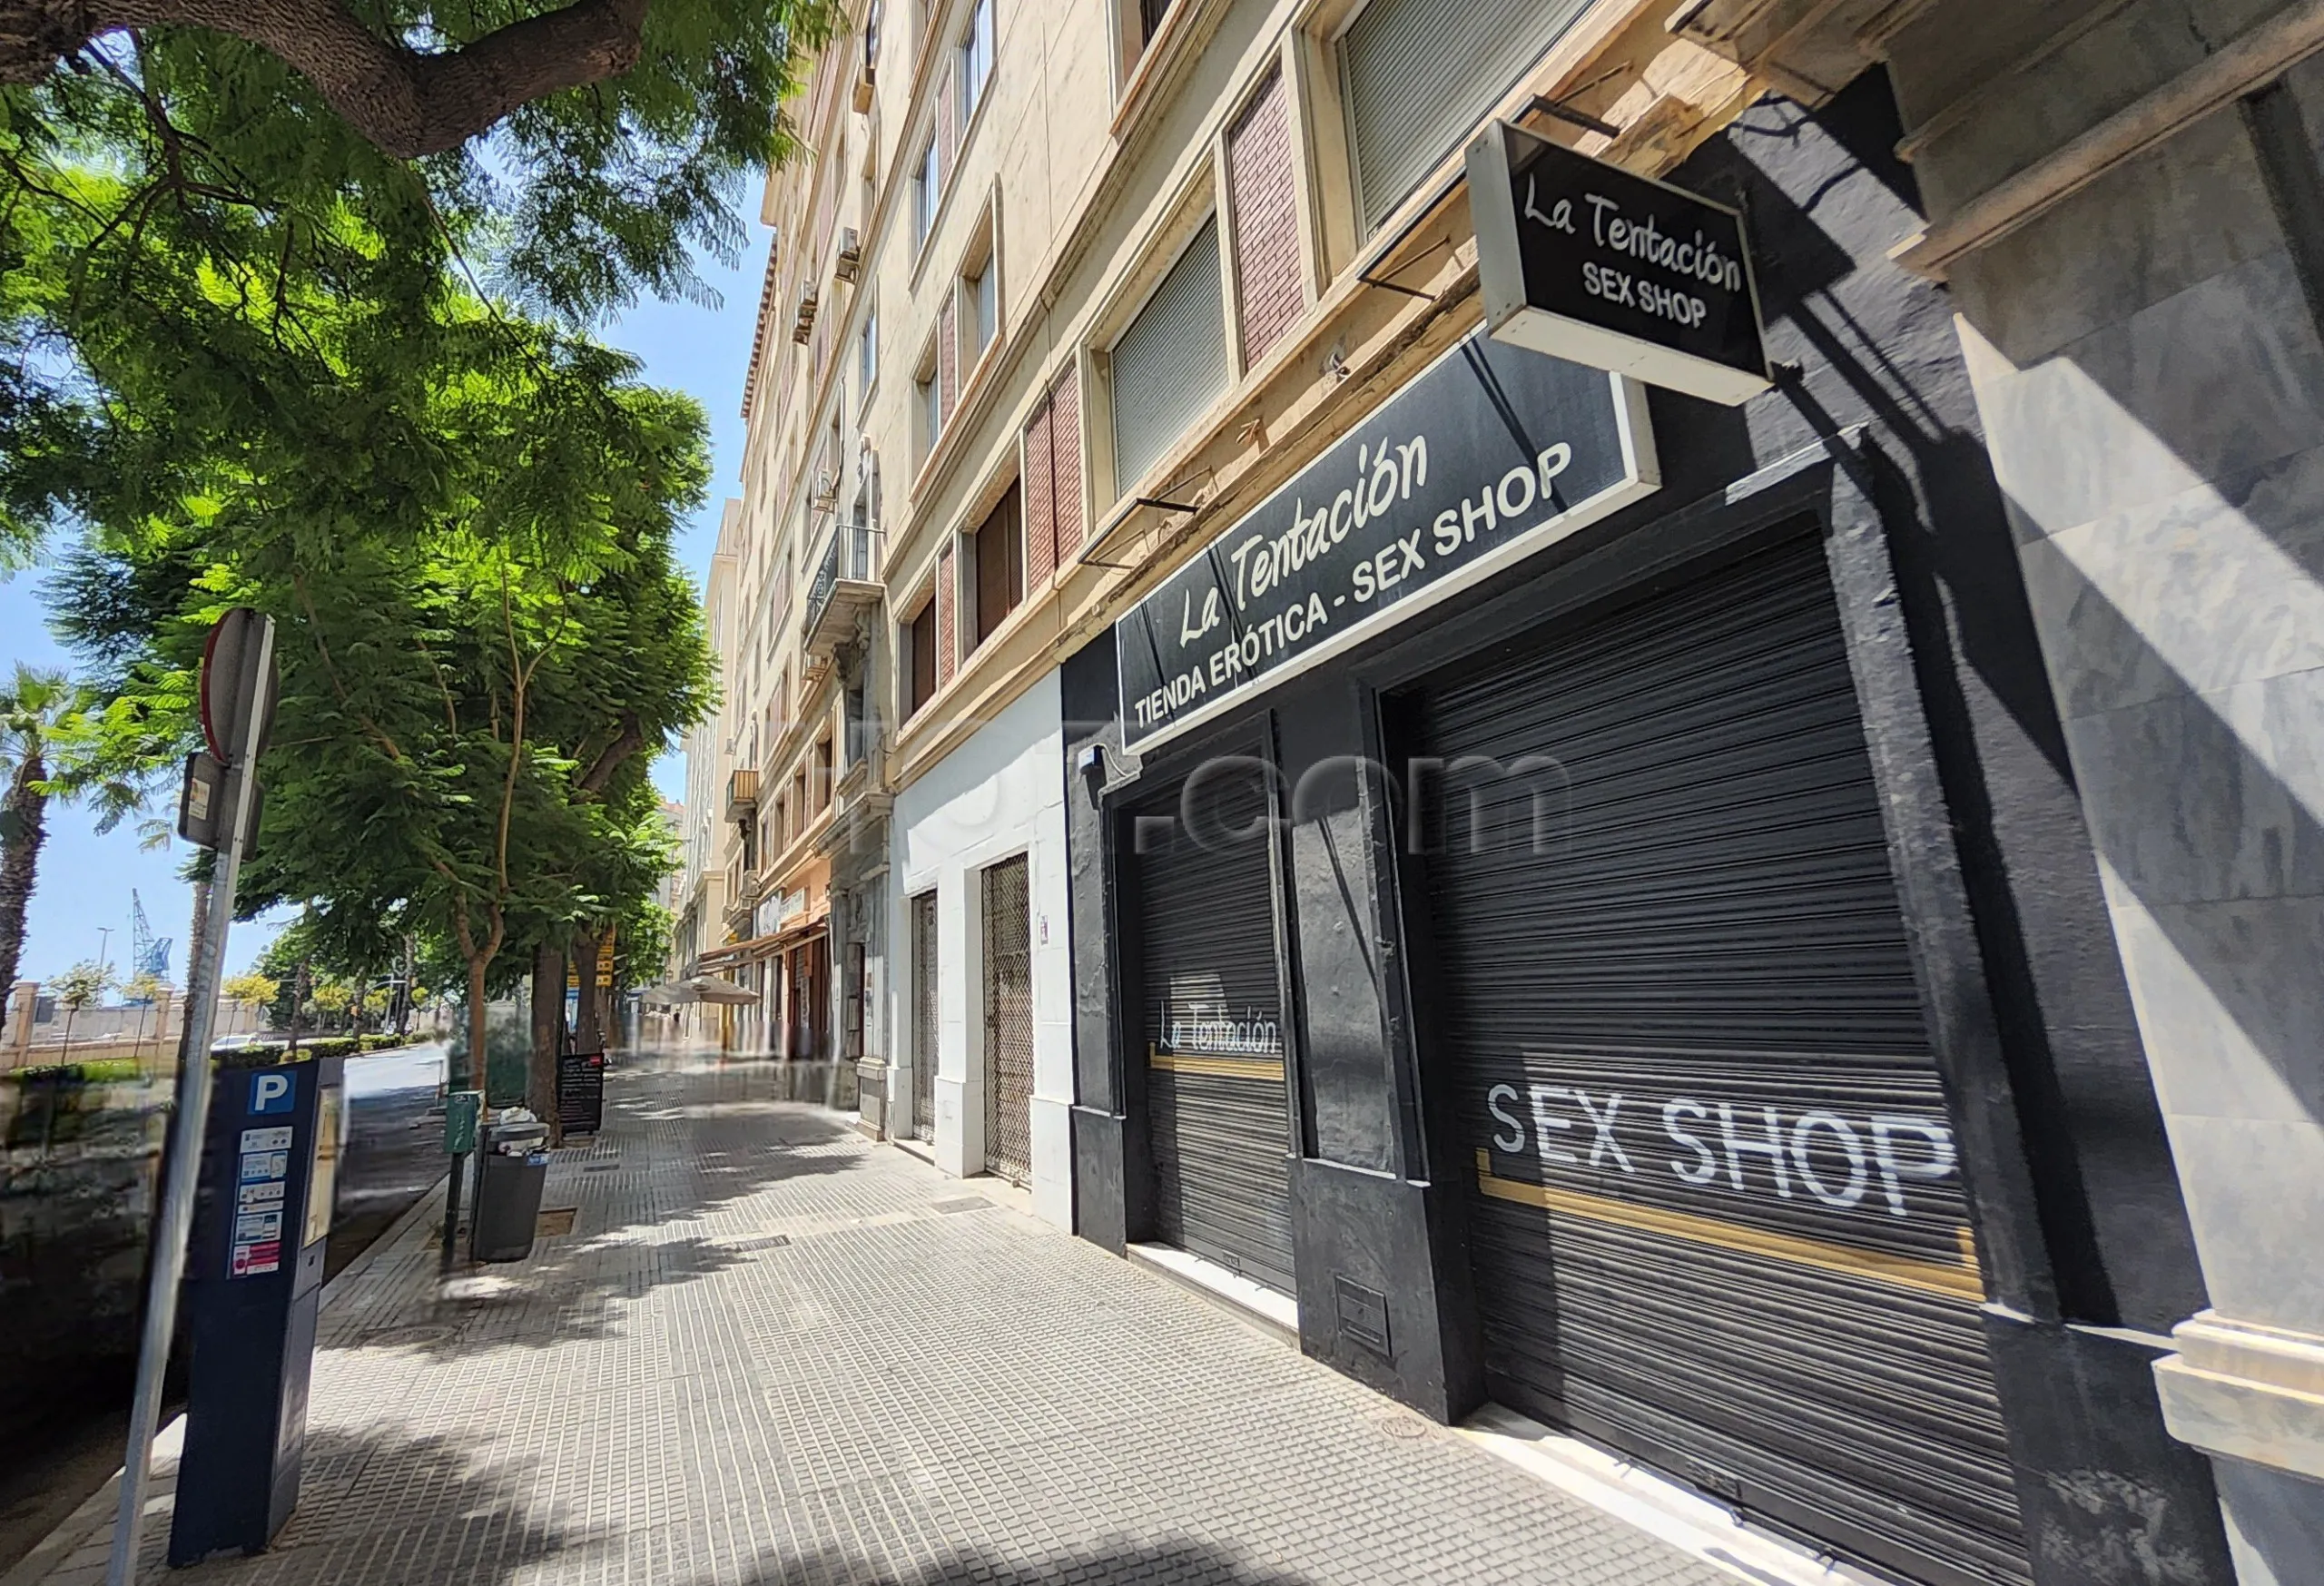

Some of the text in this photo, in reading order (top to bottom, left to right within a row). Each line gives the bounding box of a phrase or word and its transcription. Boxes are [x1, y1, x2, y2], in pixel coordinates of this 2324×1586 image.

[1524, 172, 1741, 292] La Tentación
[1582, 261, 1707, 328] SEX SHOP
[1134, 666, 1206, 729] TIENDA
[1210, 598, 1328, 686] ERÓTICA
[1353, 529, 1426, 603] SEX
[1433, 441, 1572, 557] SHOP
[1180, 435, 1428, 648] La Tentación
[1159, 1000, 1182, 1049] La
[254, 1074, 289, 1111] P
[1487, 1084, 1958, 1216] SEX SHOP
